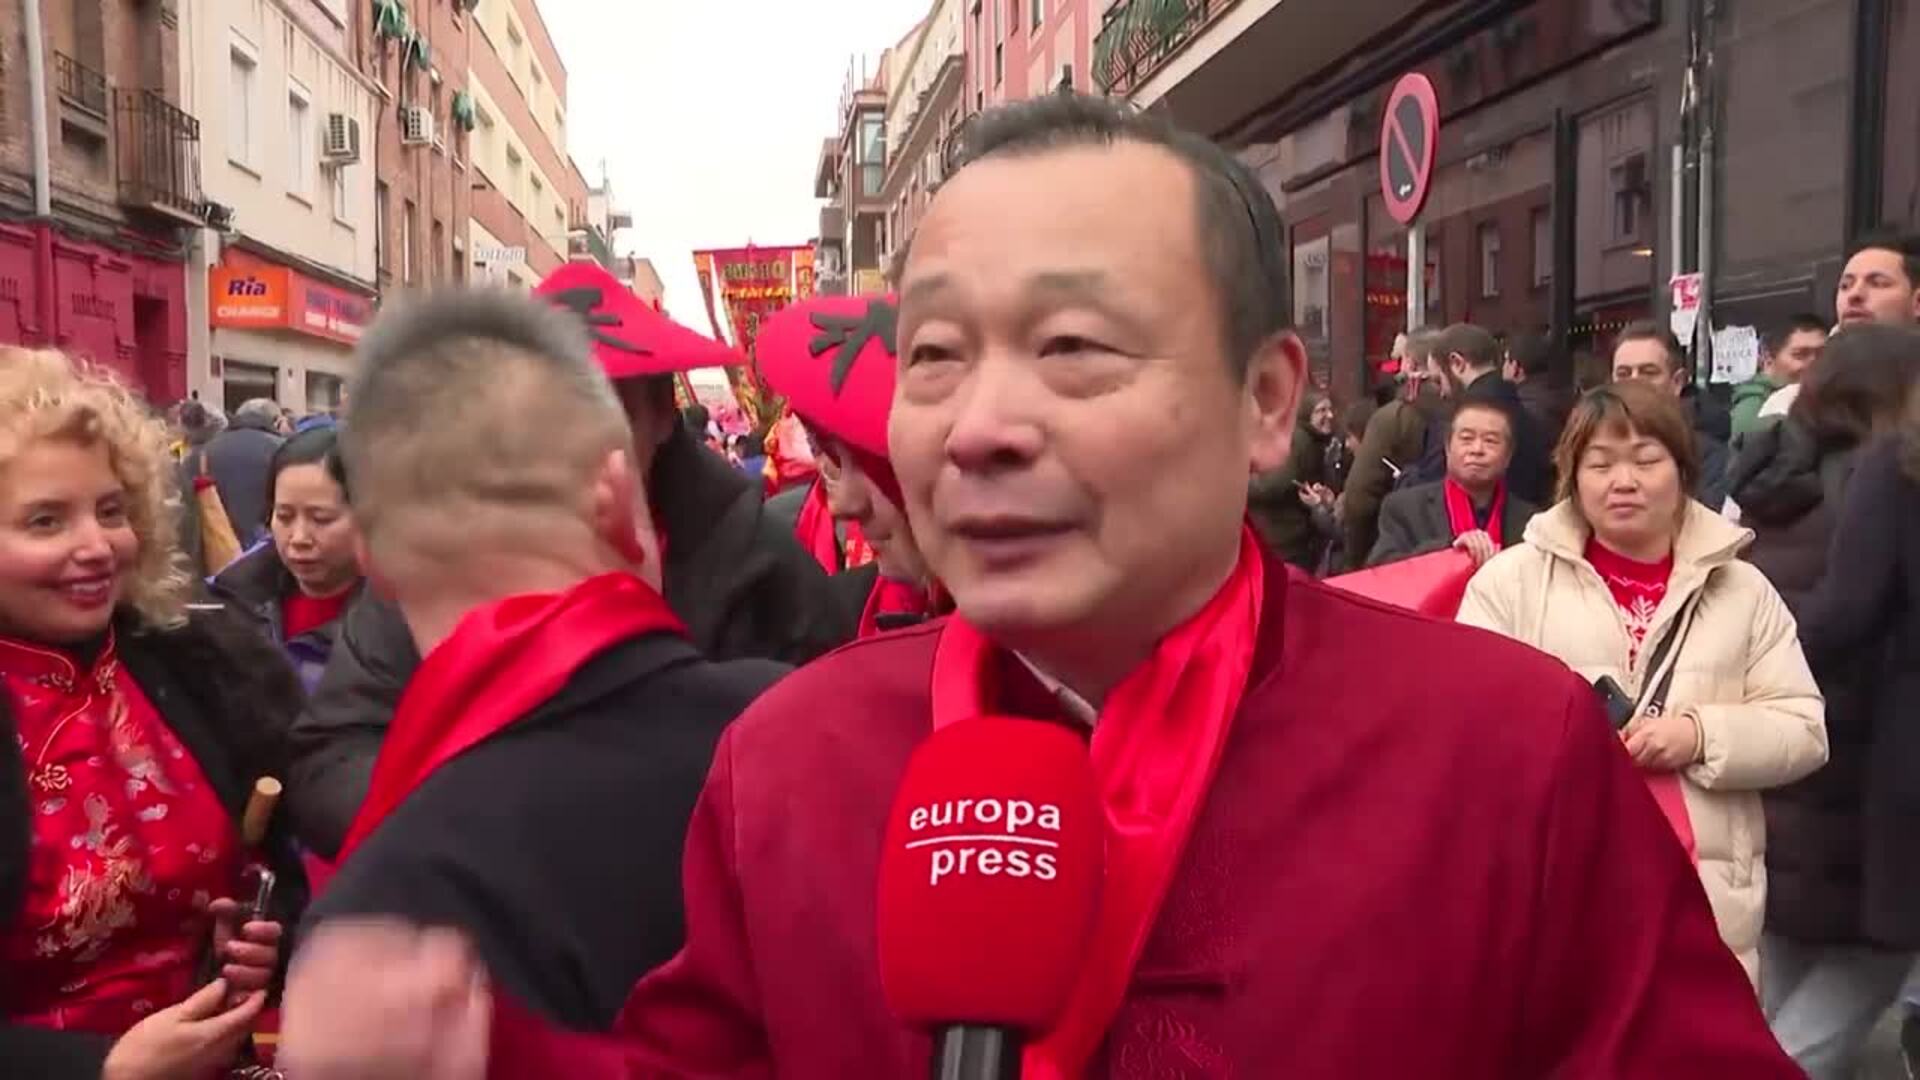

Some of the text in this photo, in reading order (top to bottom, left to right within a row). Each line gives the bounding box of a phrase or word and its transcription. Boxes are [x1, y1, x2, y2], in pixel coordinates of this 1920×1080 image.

[228, 276, 266, 295] Ria
[910, 799, 1060, 833] europa
[930, 847, 1057, 886] press
